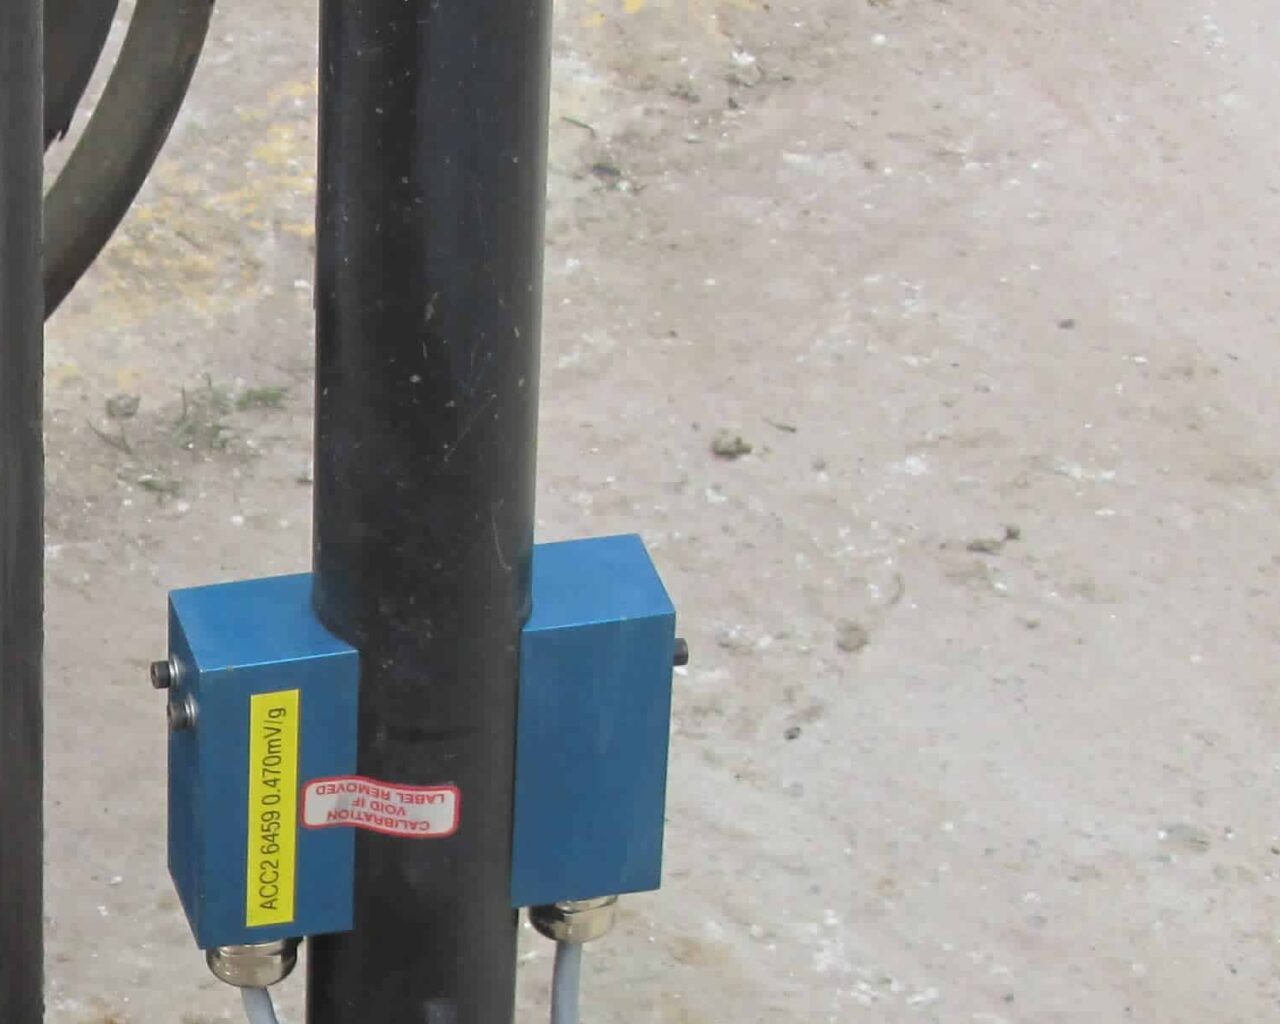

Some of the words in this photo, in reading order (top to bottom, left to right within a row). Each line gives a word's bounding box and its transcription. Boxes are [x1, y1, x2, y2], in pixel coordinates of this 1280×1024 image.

[261, 706, 287, 805] 0.470mV/g
[315, 782, 392, 801] REMOVED
[395, 791, 446, 805] LABEL
[352, 797, 365, 807] IF
[370, 801, 407, 816] VOID
[326, 809, 431, 831] CALIBRATION
[260, 808, 282, 857] 6459
[259, 860, 280, 910] ACC2
